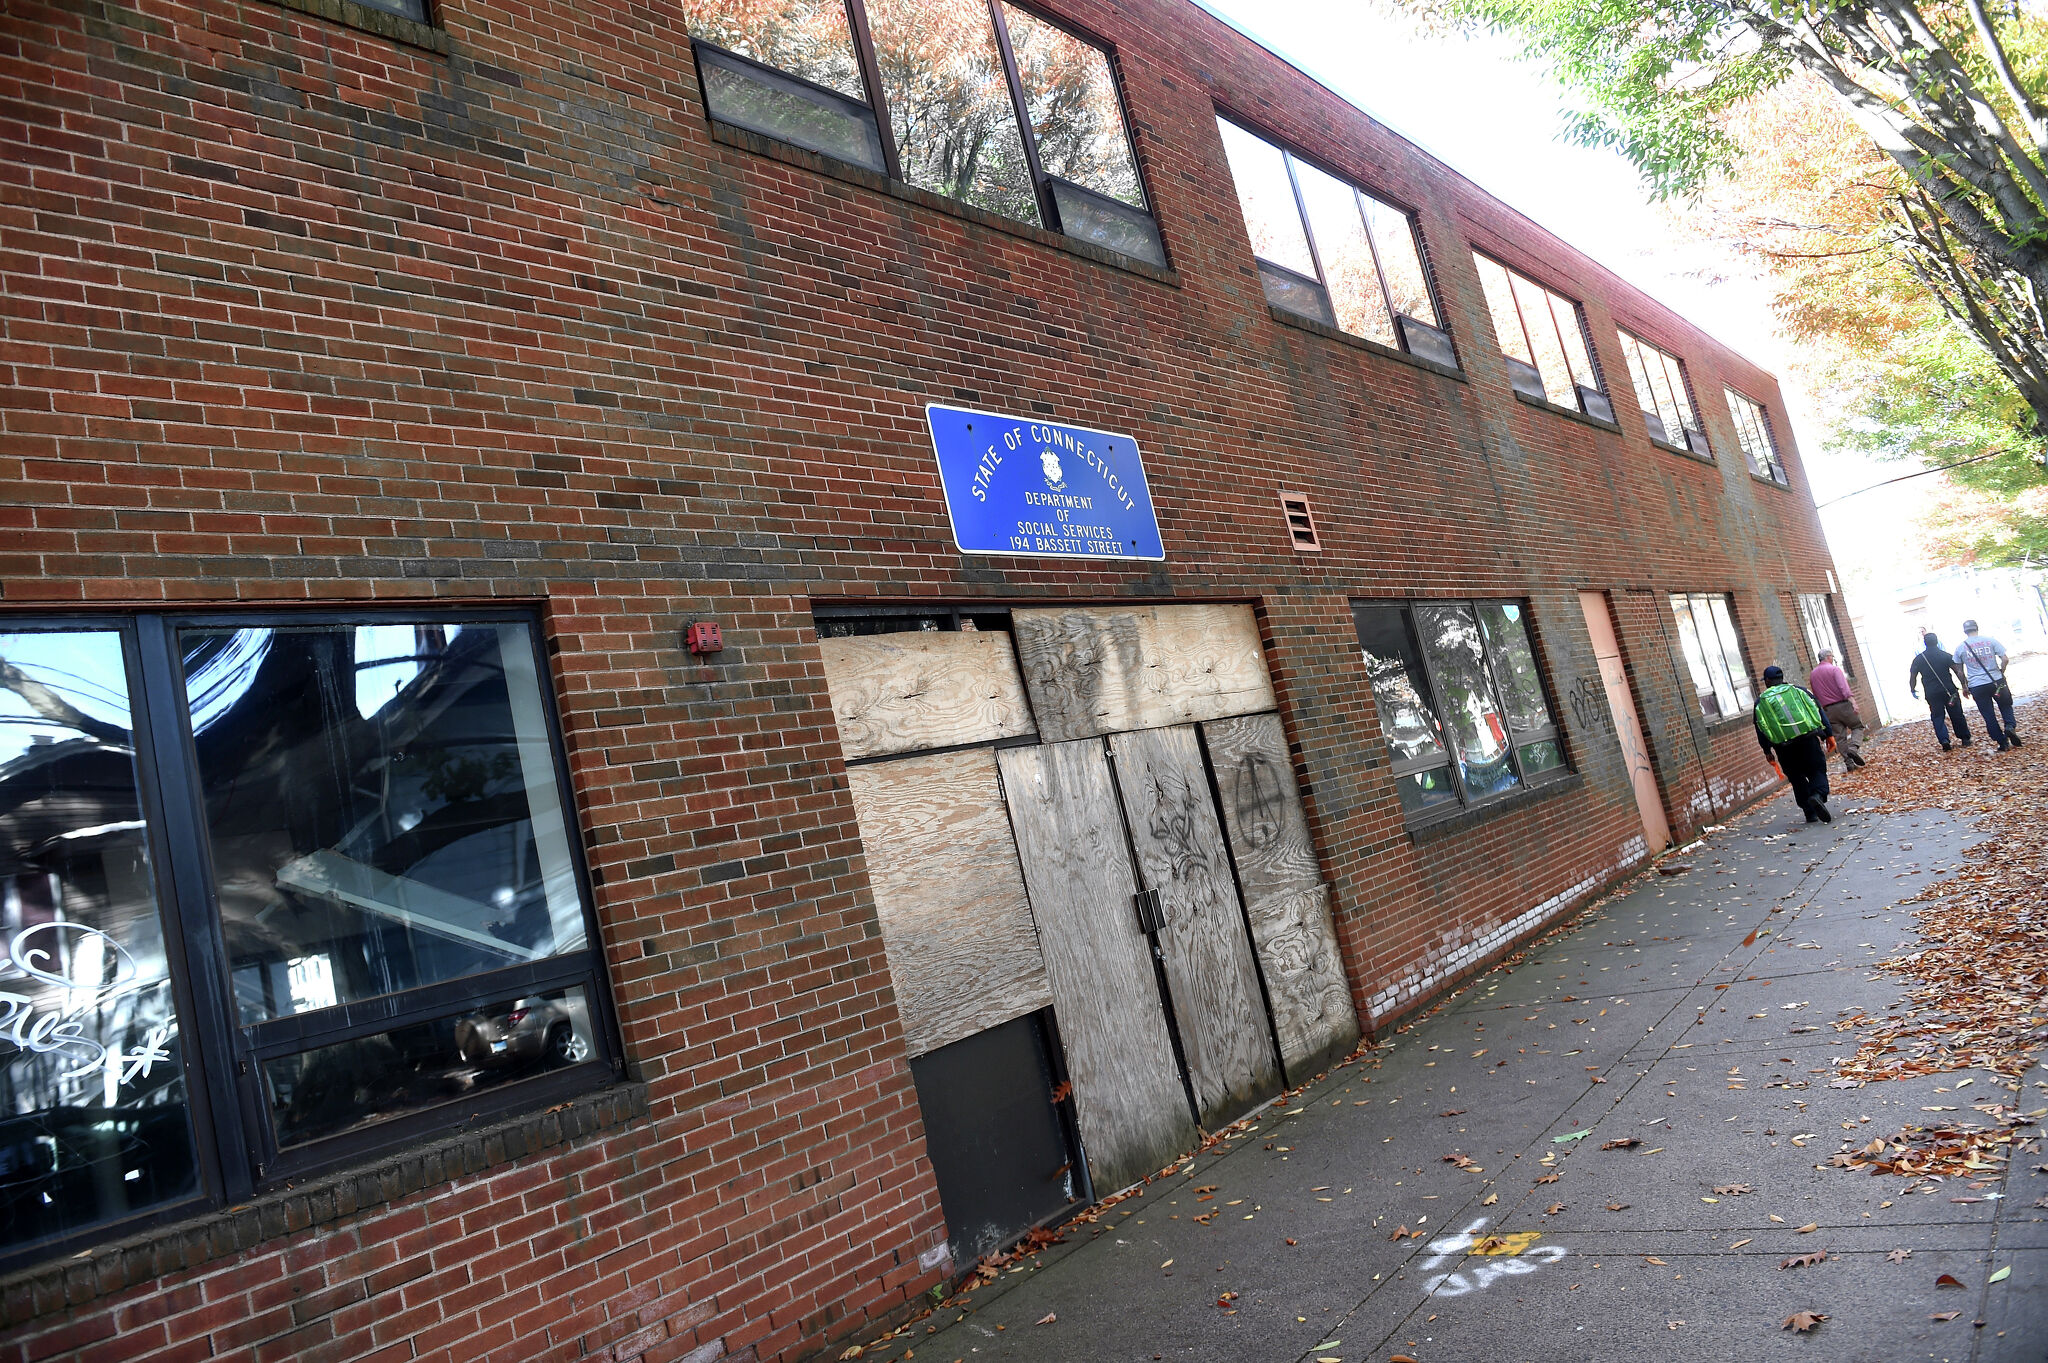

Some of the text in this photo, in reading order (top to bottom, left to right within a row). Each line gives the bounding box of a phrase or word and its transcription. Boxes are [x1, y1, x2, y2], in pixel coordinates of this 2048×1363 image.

[972, 424, 1135, 512] STATE OF CONNECTICUT
[1025, 491, 1093, 510] DEPARTMENT
[1056, 509, 1070, 523] OF
[1017, 521, 1113, 540] SOCIAL SERVICES
[1009, 536, 1124, 555] 194 BASSETT STREET
